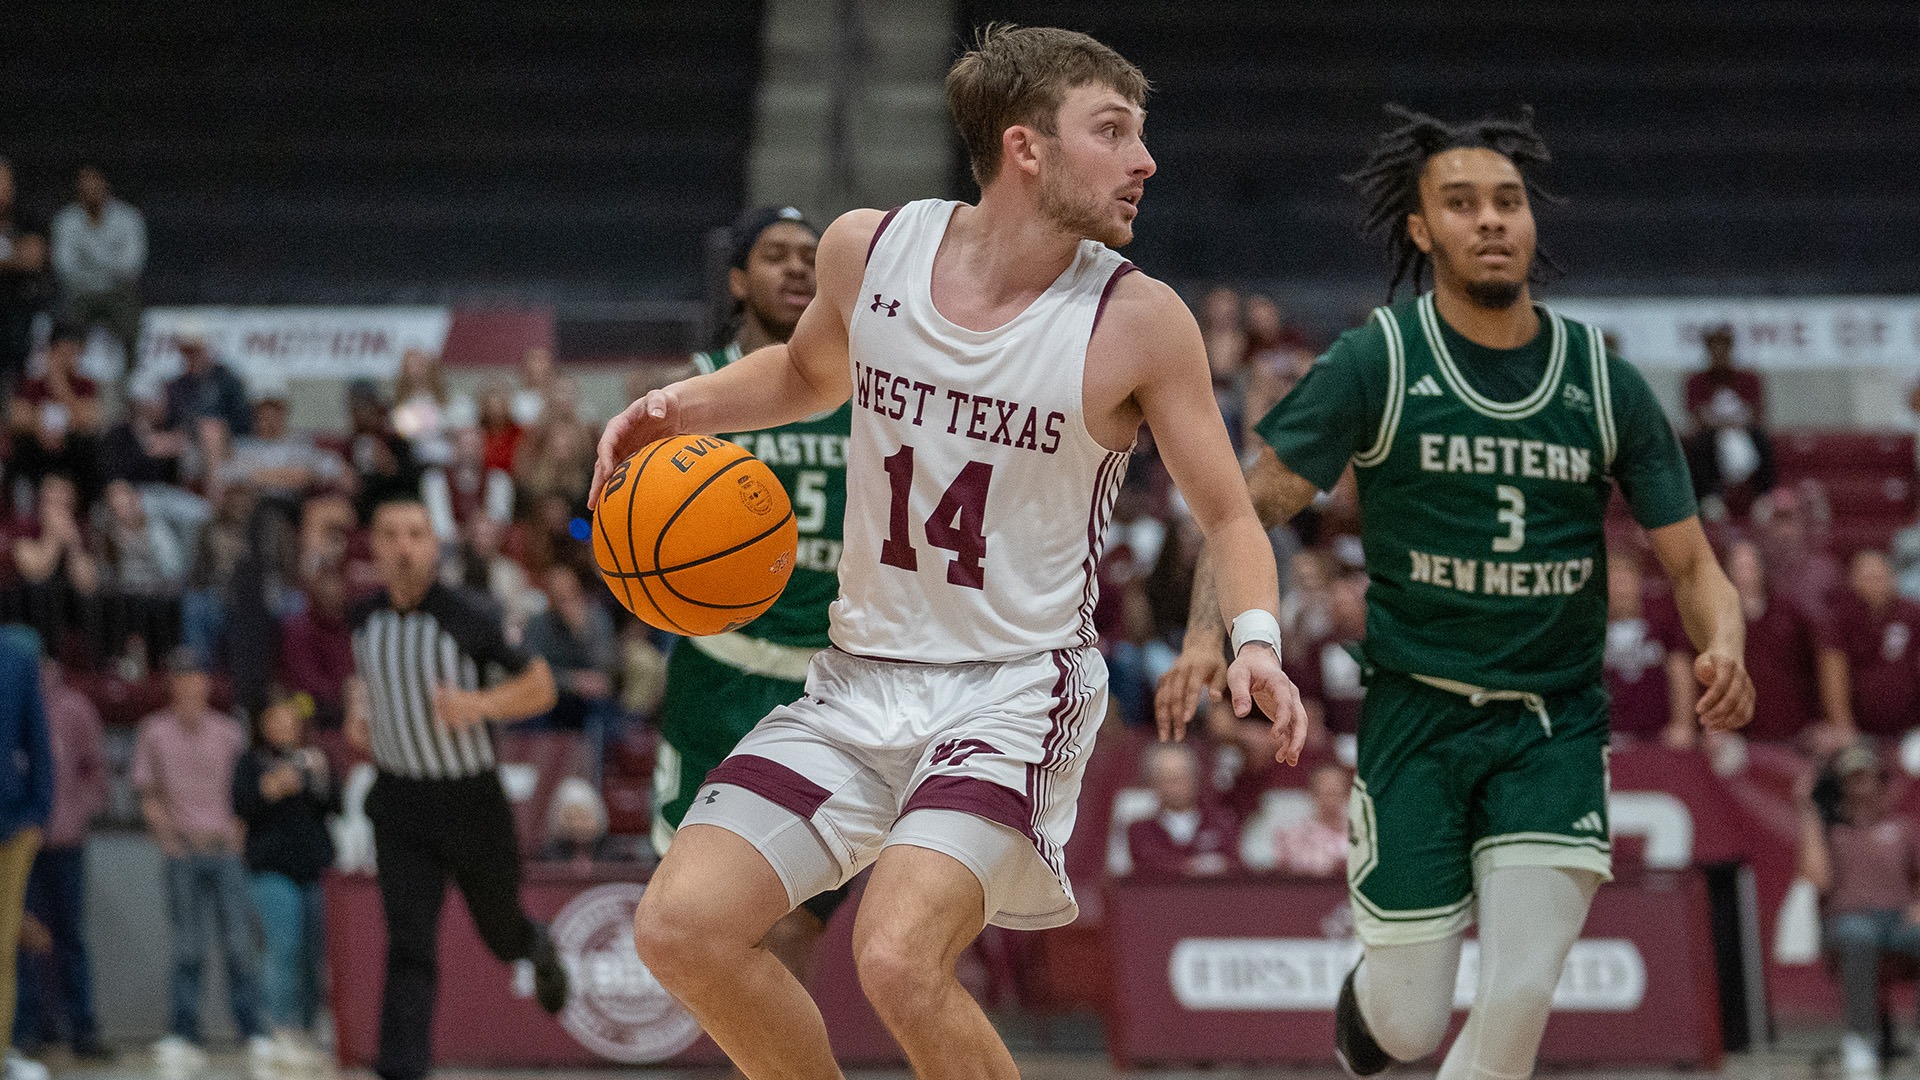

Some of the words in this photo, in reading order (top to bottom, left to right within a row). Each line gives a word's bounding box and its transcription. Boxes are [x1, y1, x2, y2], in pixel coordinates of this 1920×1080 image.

[855, 361, 936, 427] WEST
[946, 389, 1066, 455] TEXAS
[732, 432, 850, 468] EASTE
[1419, 433, 1592, 483] EASTERN
[796, 470, 829, 533] 5
[880, 444, 994, 590] 14
[1492, 484, 1526, 553] 3
[1410, 550, 1477, 594] NEW
[1483, 557, 1594, 597] MEXICO
